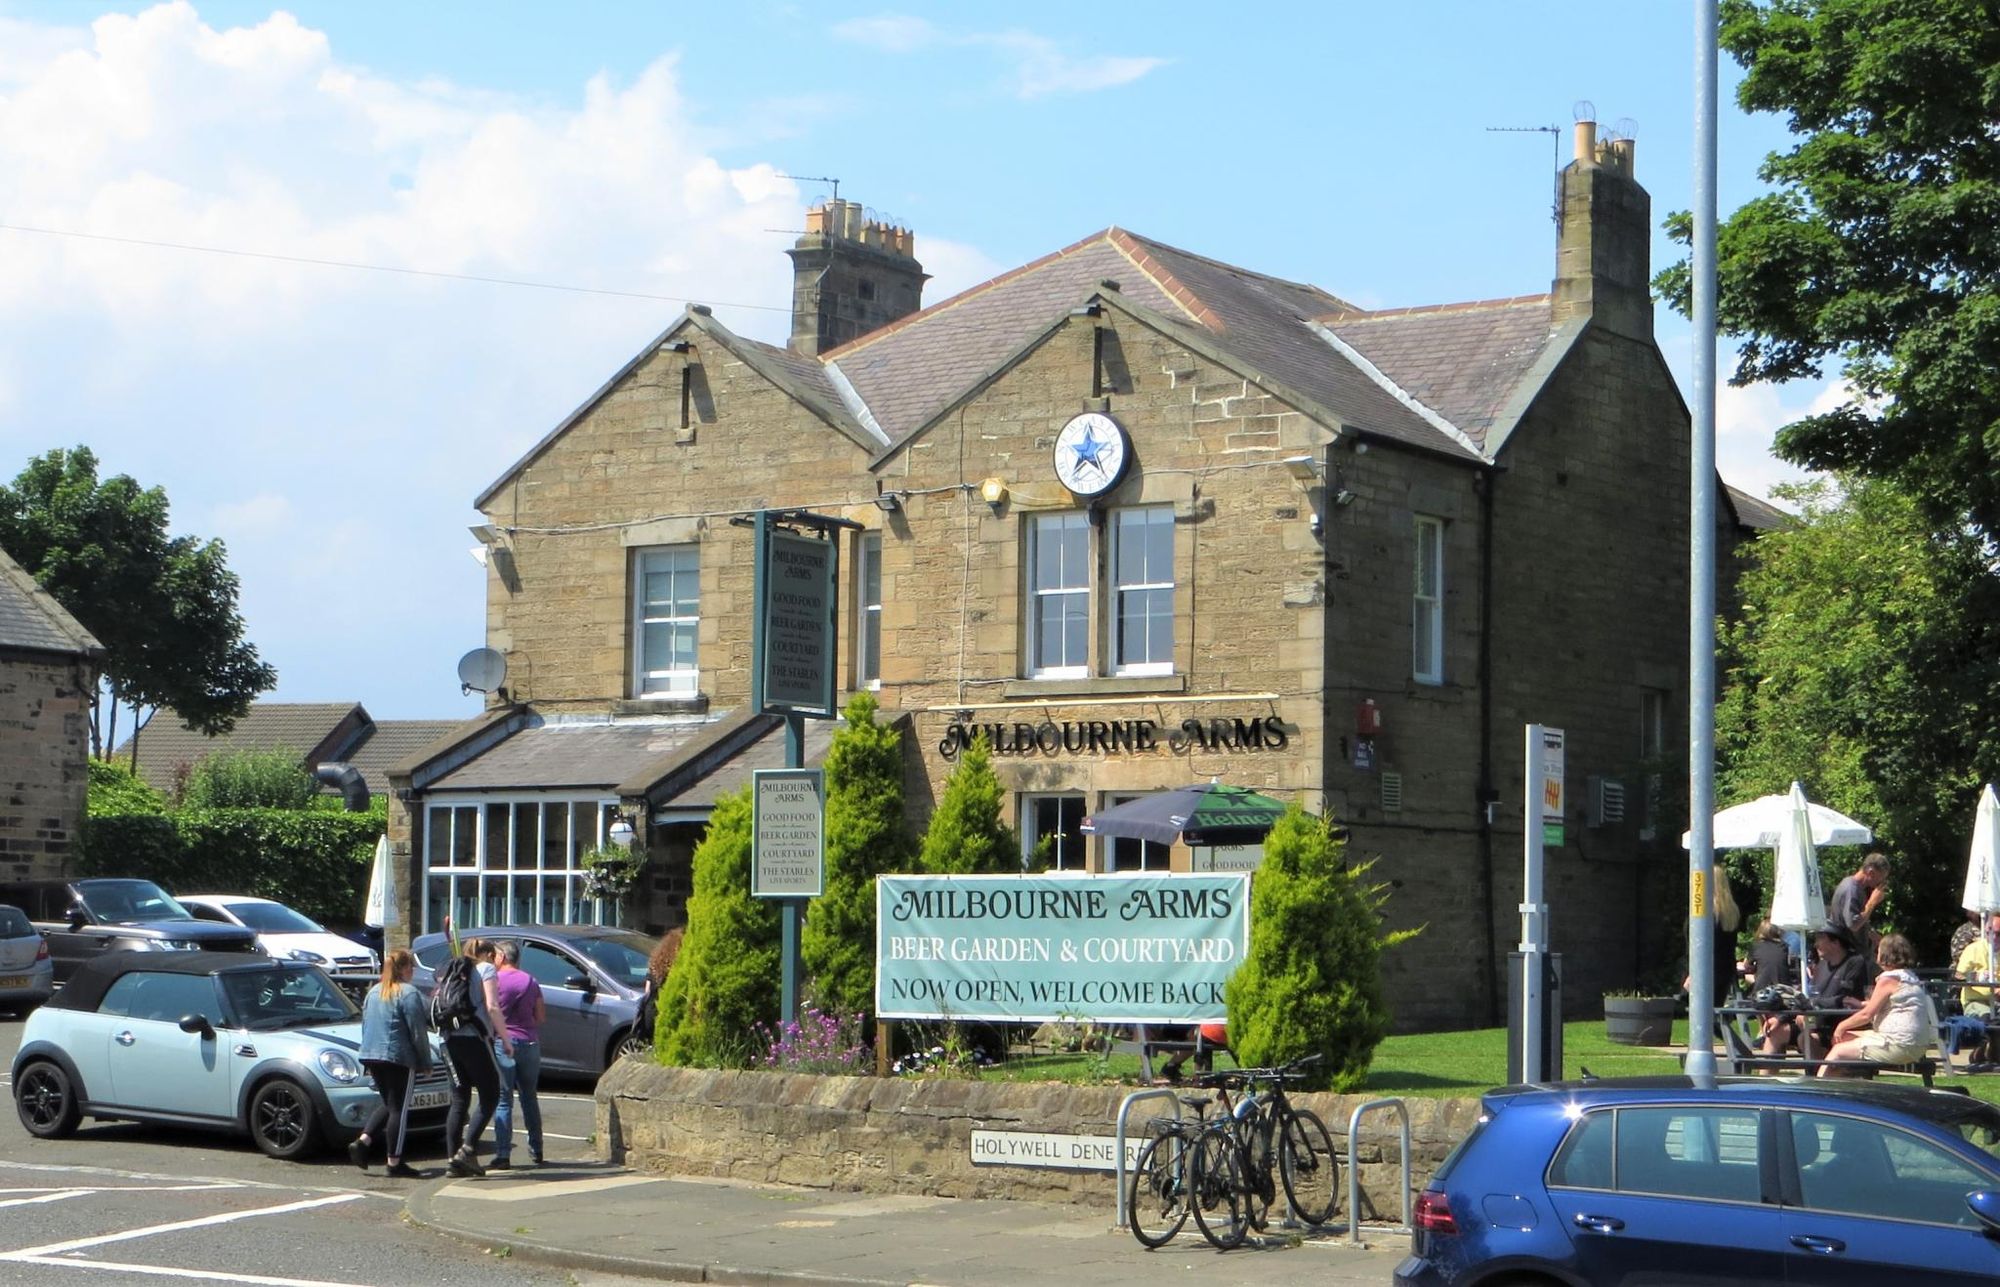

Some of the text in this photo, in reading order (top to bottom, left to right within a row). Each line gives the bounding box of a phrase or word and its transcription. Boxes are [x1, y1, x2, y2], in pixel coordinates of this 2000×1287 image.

[773, 550, 824, 569] MILBOURNE
[784, 567, 812, 580] ARMS
[773, 592, 821, 608] GOOD FOOD
[790, 618, 822, 632] GARDEN
[772, 641, 819, 656] COURTYARD
[772, 664, 788, 676] THE
[939, 715, 1288, 757] MILBOURNE ARMS
[761, 783, 816, 793] MILBOURNE
[775, 793, 805, 803] ARMS
[762, 812, 816, 821] GOOD FOOD
[1194, 811, 1278, 827] Heine
[760, 831, 817, 840] BEER GARDEN
[762, 849, 815, 858] COURTYARD
[763, 867, 815, 875] THE STABLES
[1229, 861, 1256, 870] FOOD
[892, 888, 1232, 921] MILBOURNE ARMS
[890, 936, 1234, 963] BEER GARDEN & COURTYARD
[891, 977, 1226, 1006] NOW OPEN, WELCOME BACK
[975, 1138, 1061, 1158] HOLYWELL
[1071, 1143, 1114, 1161] DENE
